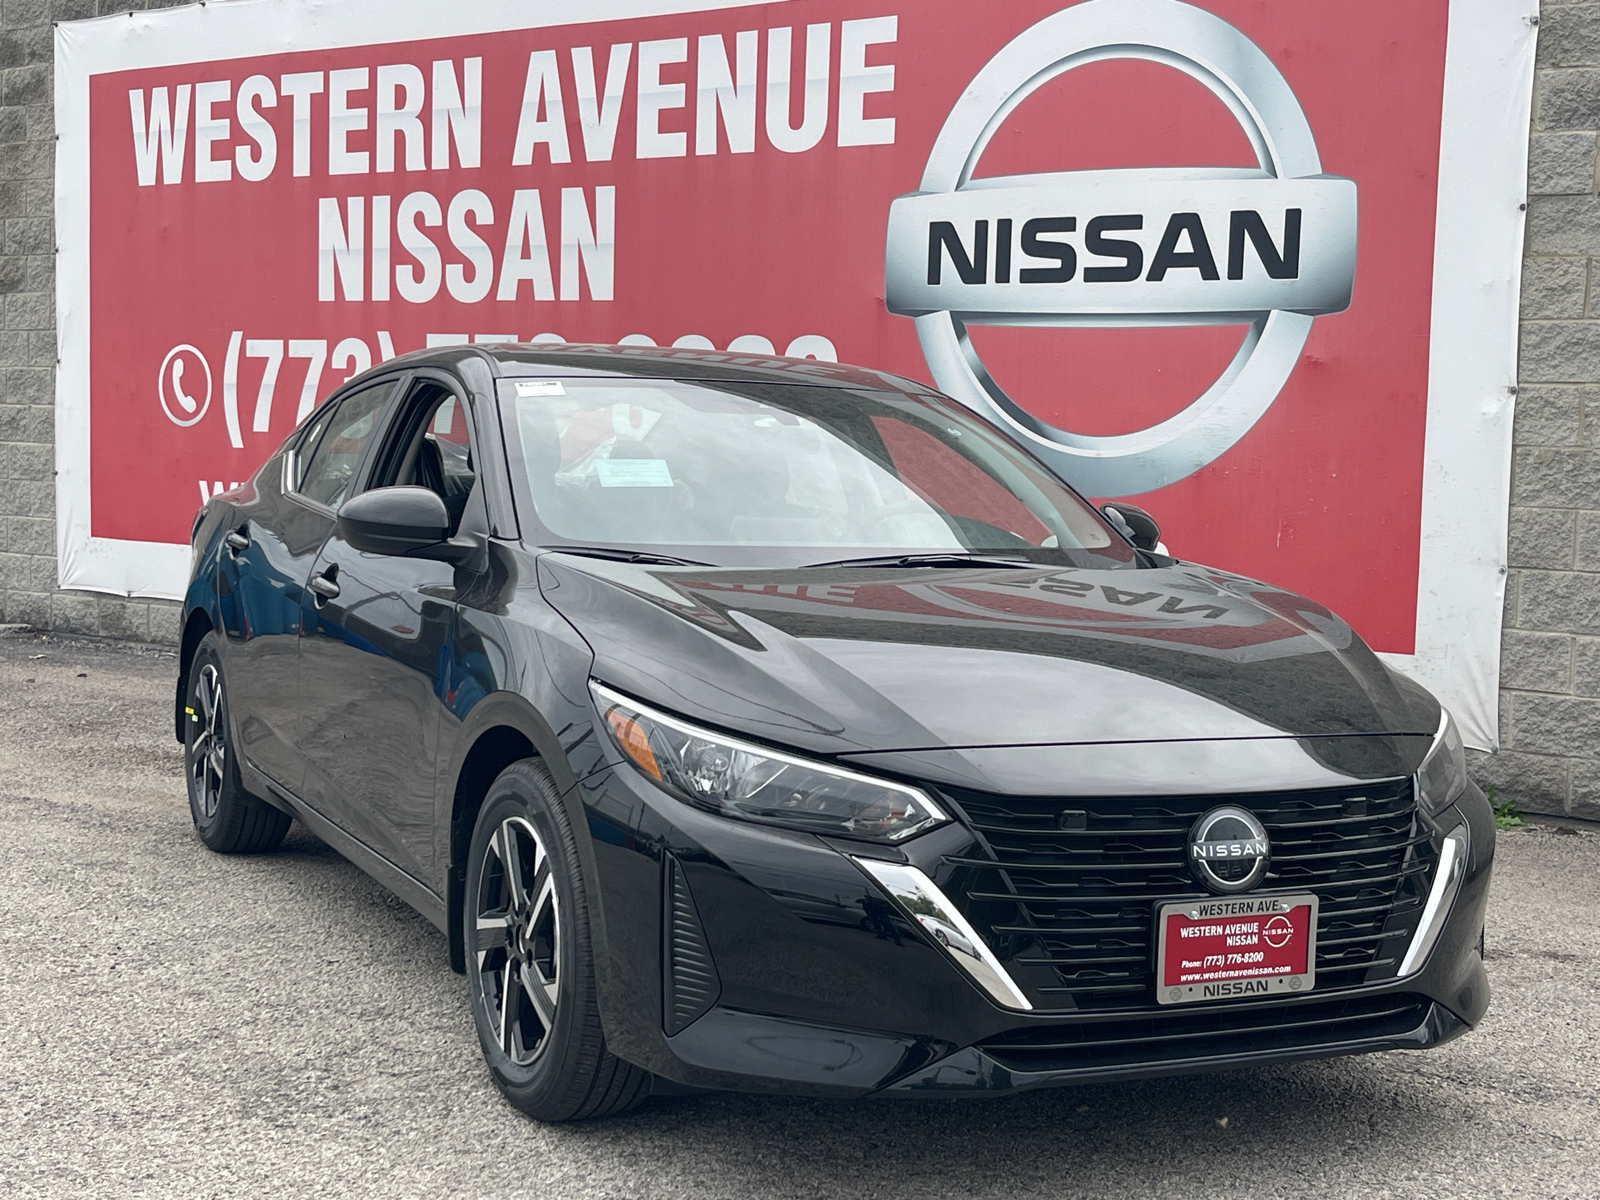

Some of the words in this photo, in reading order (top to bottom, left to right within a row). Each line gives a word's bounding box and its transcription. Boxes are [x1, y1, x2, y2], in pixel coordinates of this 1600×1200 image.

[129, 57, 483, 187] WESTERN
[512, 15, 898, 166] AVENUE
[318, 186, 616, 304] NISSAN
[927, 208, 1302, 286] NISSAN
[1193, 842, 1266, 857] NISSAN
[1199, 901, 1254, 917] WESTERN
[1180, 925, 1223, 938] WESTERN
[1224, 922, 1259, 935] AVENUE
[1262, 928, 1294, 936] NISSAN
[1226, 934, 1259, 947] NISSAN
[1181, 960, 1202, 968] Phone:
[1203, 955, 1226, 969] (773)
[1226, 952, 1264, 965] 776-8200
[1180, 965, 1292, 982] www.westernavenissan.com
[1203, 979, 1269, 998] NISSAN
